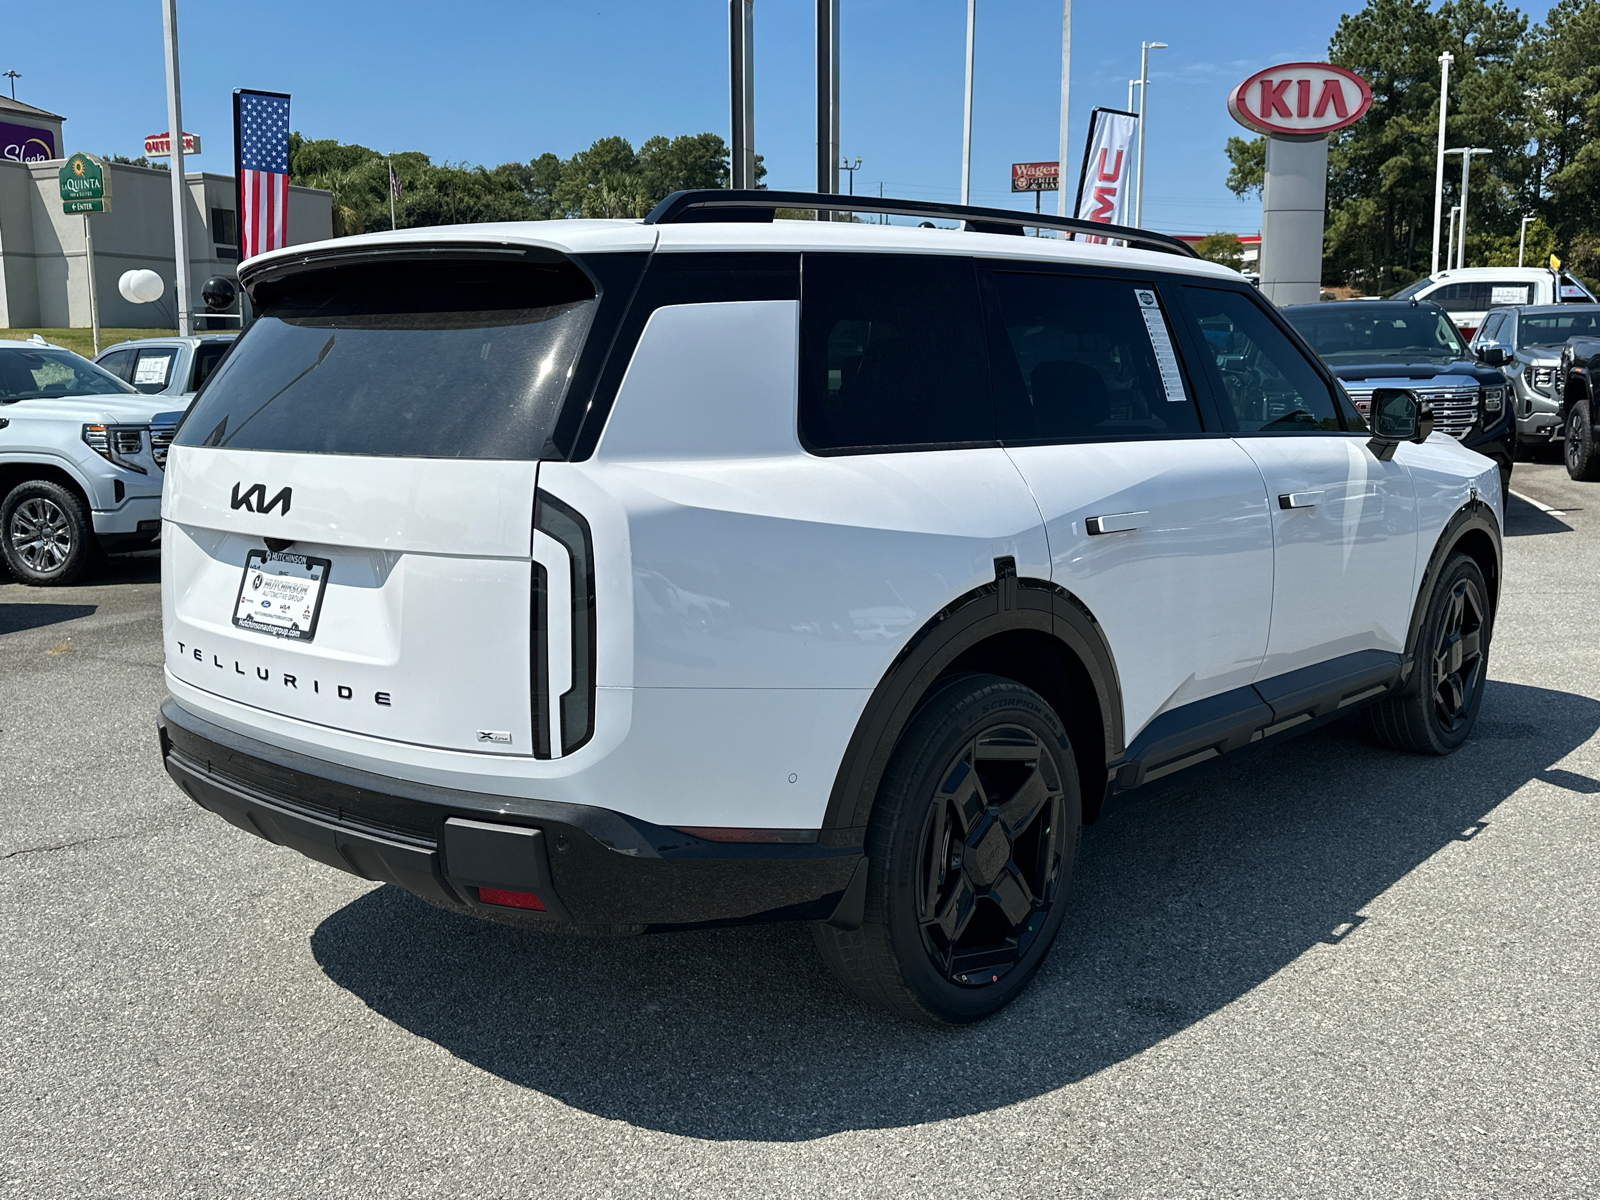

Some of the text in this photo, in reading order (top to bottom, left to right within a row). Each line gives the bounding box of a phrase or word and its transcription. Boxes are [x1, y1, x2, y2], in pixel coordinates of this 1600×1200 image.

[1260, 79, 1348, 118] KIA
[145, 138, 193, 151] OUTBK
[66, 178, 101, 193] QUINTA
[76, 202, 94, 211] ENTER
[230, 481, 293, 518] KIA
[272, 552, 307, 564] HUTCHINSON
[288, 595, 304, 603] GROUP
[177, 641, 392, 708] TELLURIDE
[983, 698, 1041, 715] SCORPION
